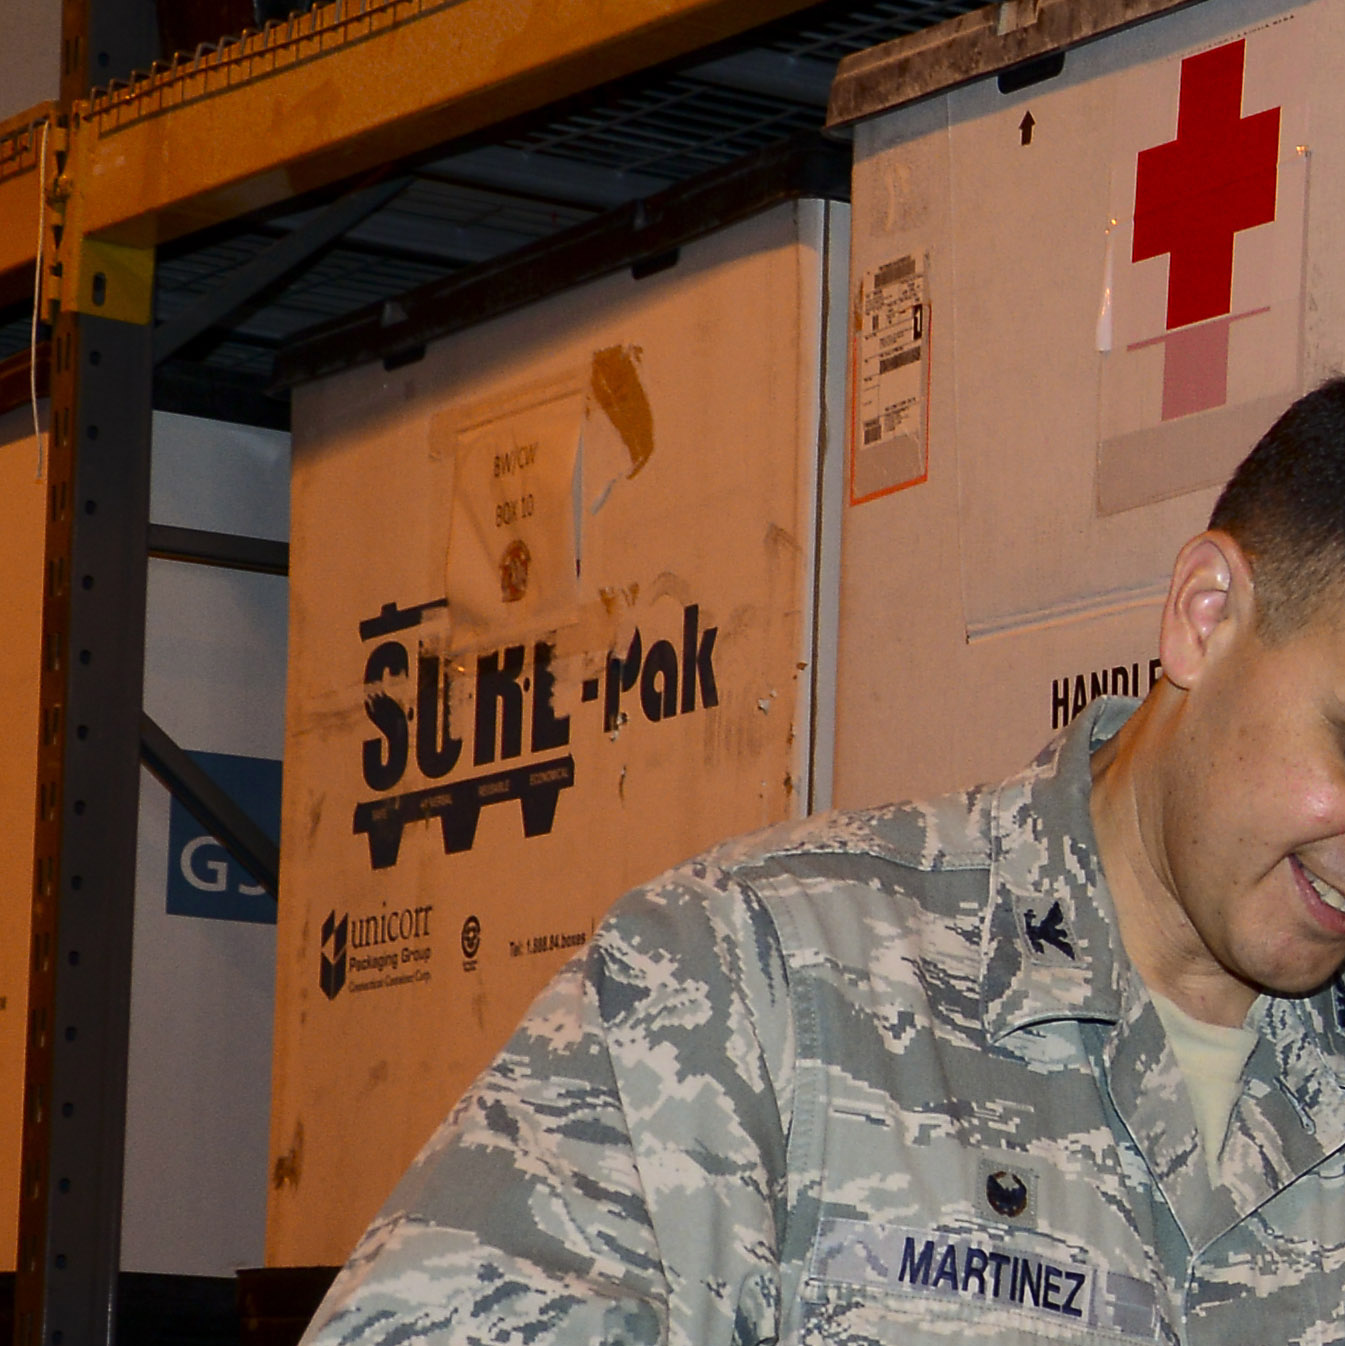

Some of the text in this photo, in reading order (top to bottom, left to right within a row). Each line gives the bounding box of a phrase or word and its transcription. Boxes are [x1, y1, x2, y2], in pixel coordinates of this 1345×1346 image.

[351, 902, 433, 949] unicorr
[350, 947, 431, 972] Packaging Group
[898, 1237, 1085, 1317] MARTINEZ
